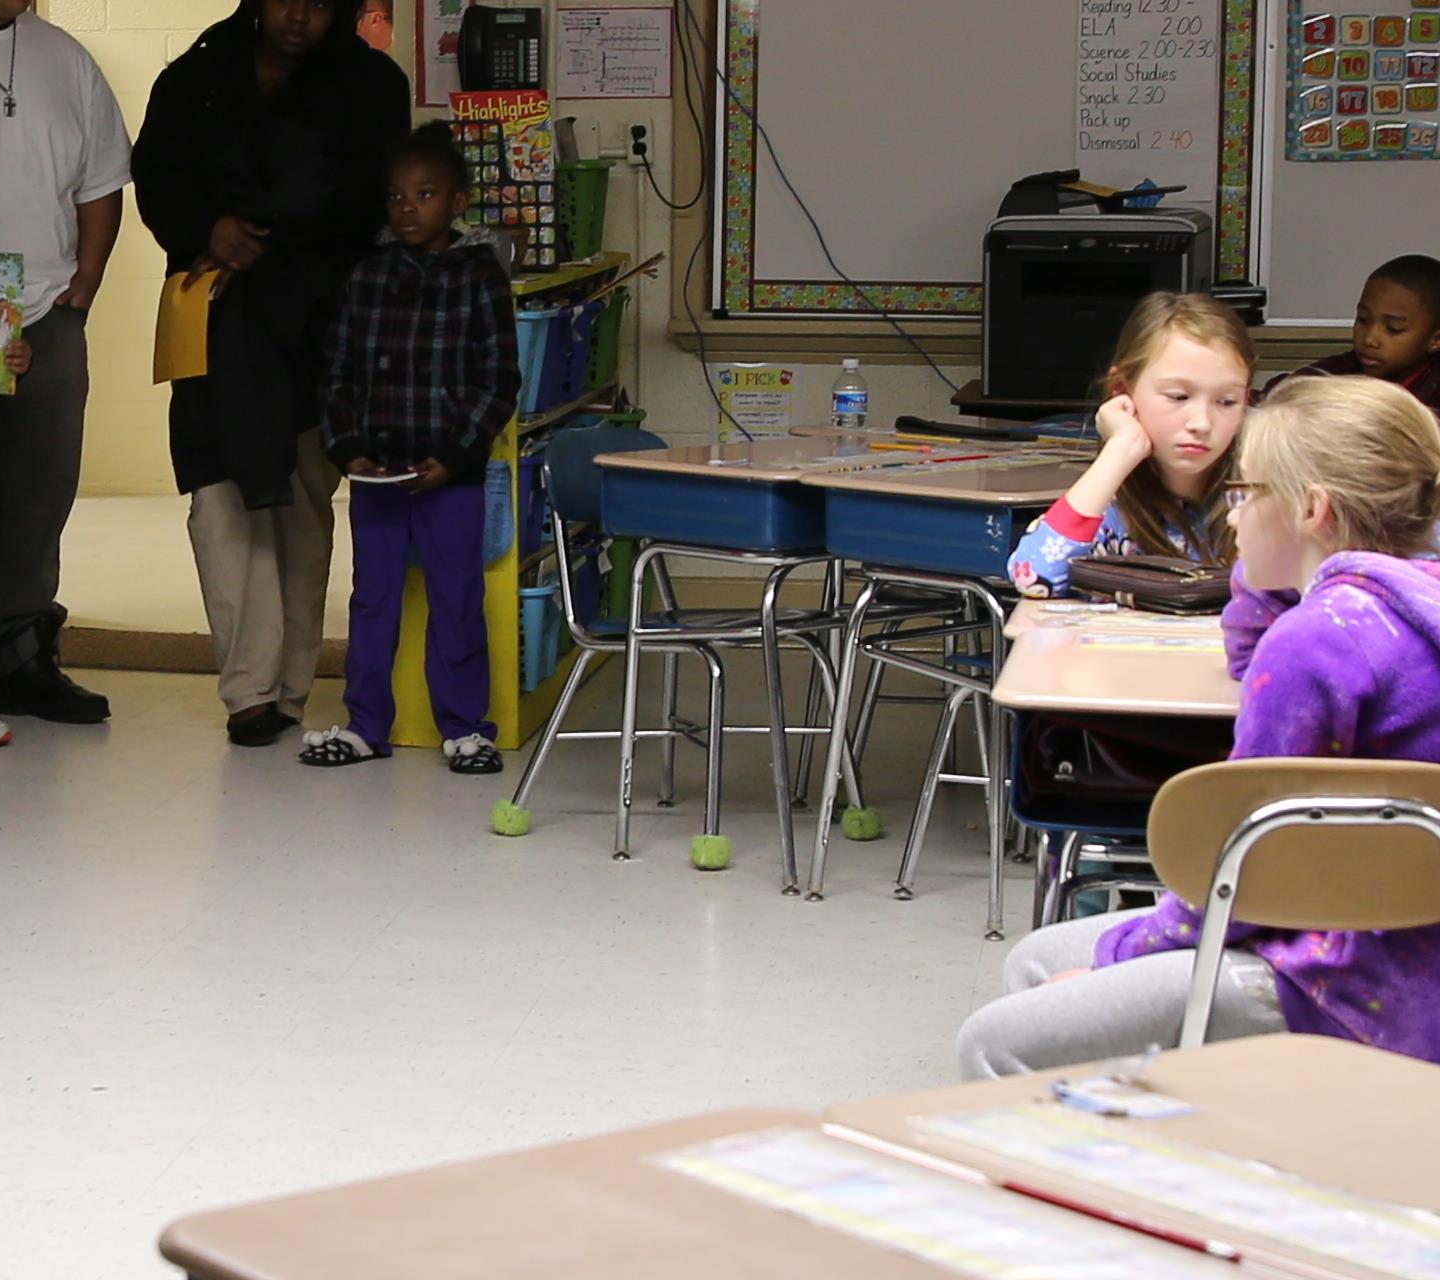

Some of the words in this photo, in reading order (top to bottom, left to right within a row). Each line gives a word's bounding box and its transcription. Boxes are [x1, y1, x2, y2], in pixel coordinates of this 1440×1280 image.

[1080, 17, 1115, 36] ELA
[1160, 16, 1202, 36] 200
[1313, 22, 1328, 40] 2
[1349, 22, 1363, 39] 3
[1383, 22, 1397, 39] 4
[1420, 20, 1432, 37] 5
[1080, 40, 1130, 60] Science
[1137, 39, 1216, 60] 200-230
[1080, 62, 1118, 82] Social
[1125, 62, 1177, 82] Studies
[1342, 56, 1365, 74] 10
[1413, 56, 1434, 74] 12
[1079, 85, 1120, 105] Snack
[1128, 85, 1166, 105] 230
[1308, 93, 1328, 112] 16
[1343, 92, 1364, 109] 17
[452, 94, 550, 121] Highlights
[1080, 108, 1109, 128] Pack
[1114, 116, 1130, 133] up
[1079, 131, 1140, 150] Dismissal
[1150, 130, 1193, 150] 240
[1410, 130, 1431, 148] 26
[745, 373, 776, 386] PICK
